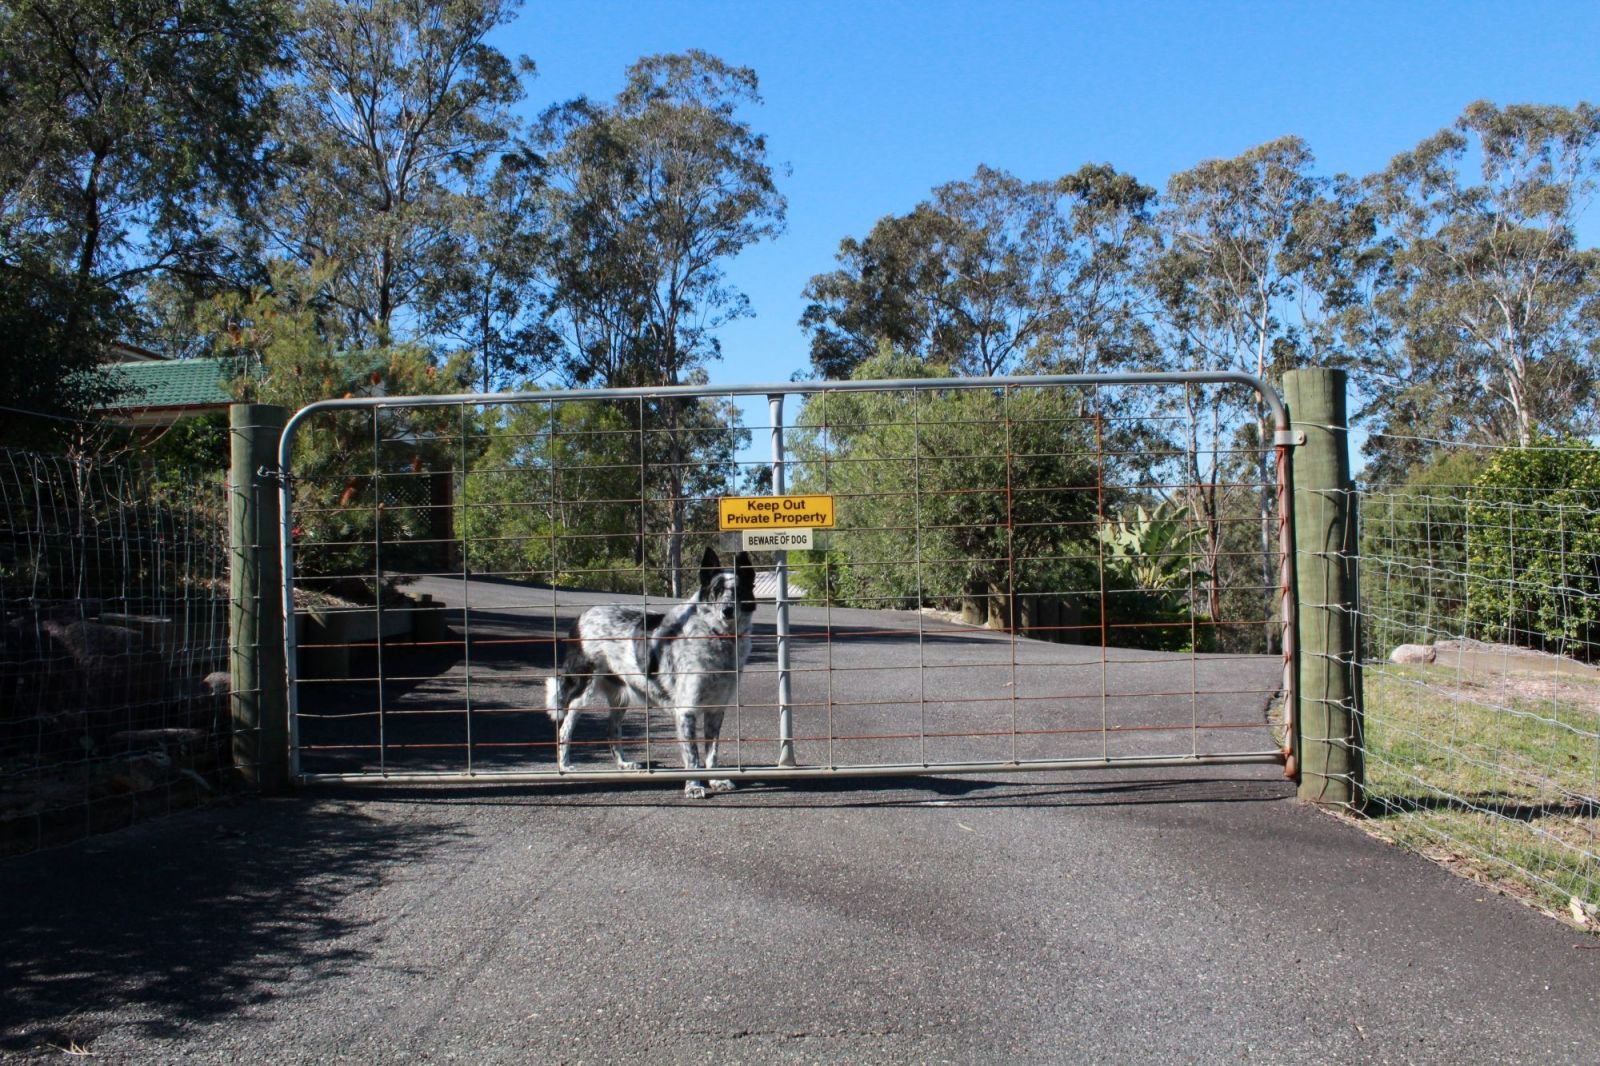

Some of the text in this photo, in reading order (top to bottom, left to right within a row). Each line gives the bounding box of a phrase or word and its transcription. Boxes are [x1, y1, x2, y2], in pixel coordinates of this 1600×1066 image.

[748, 500, 805, 512] Keep Out
[728, 512, 826, 524] Private Property
[748, 535, 807, 545] BEWARE OF DOG
